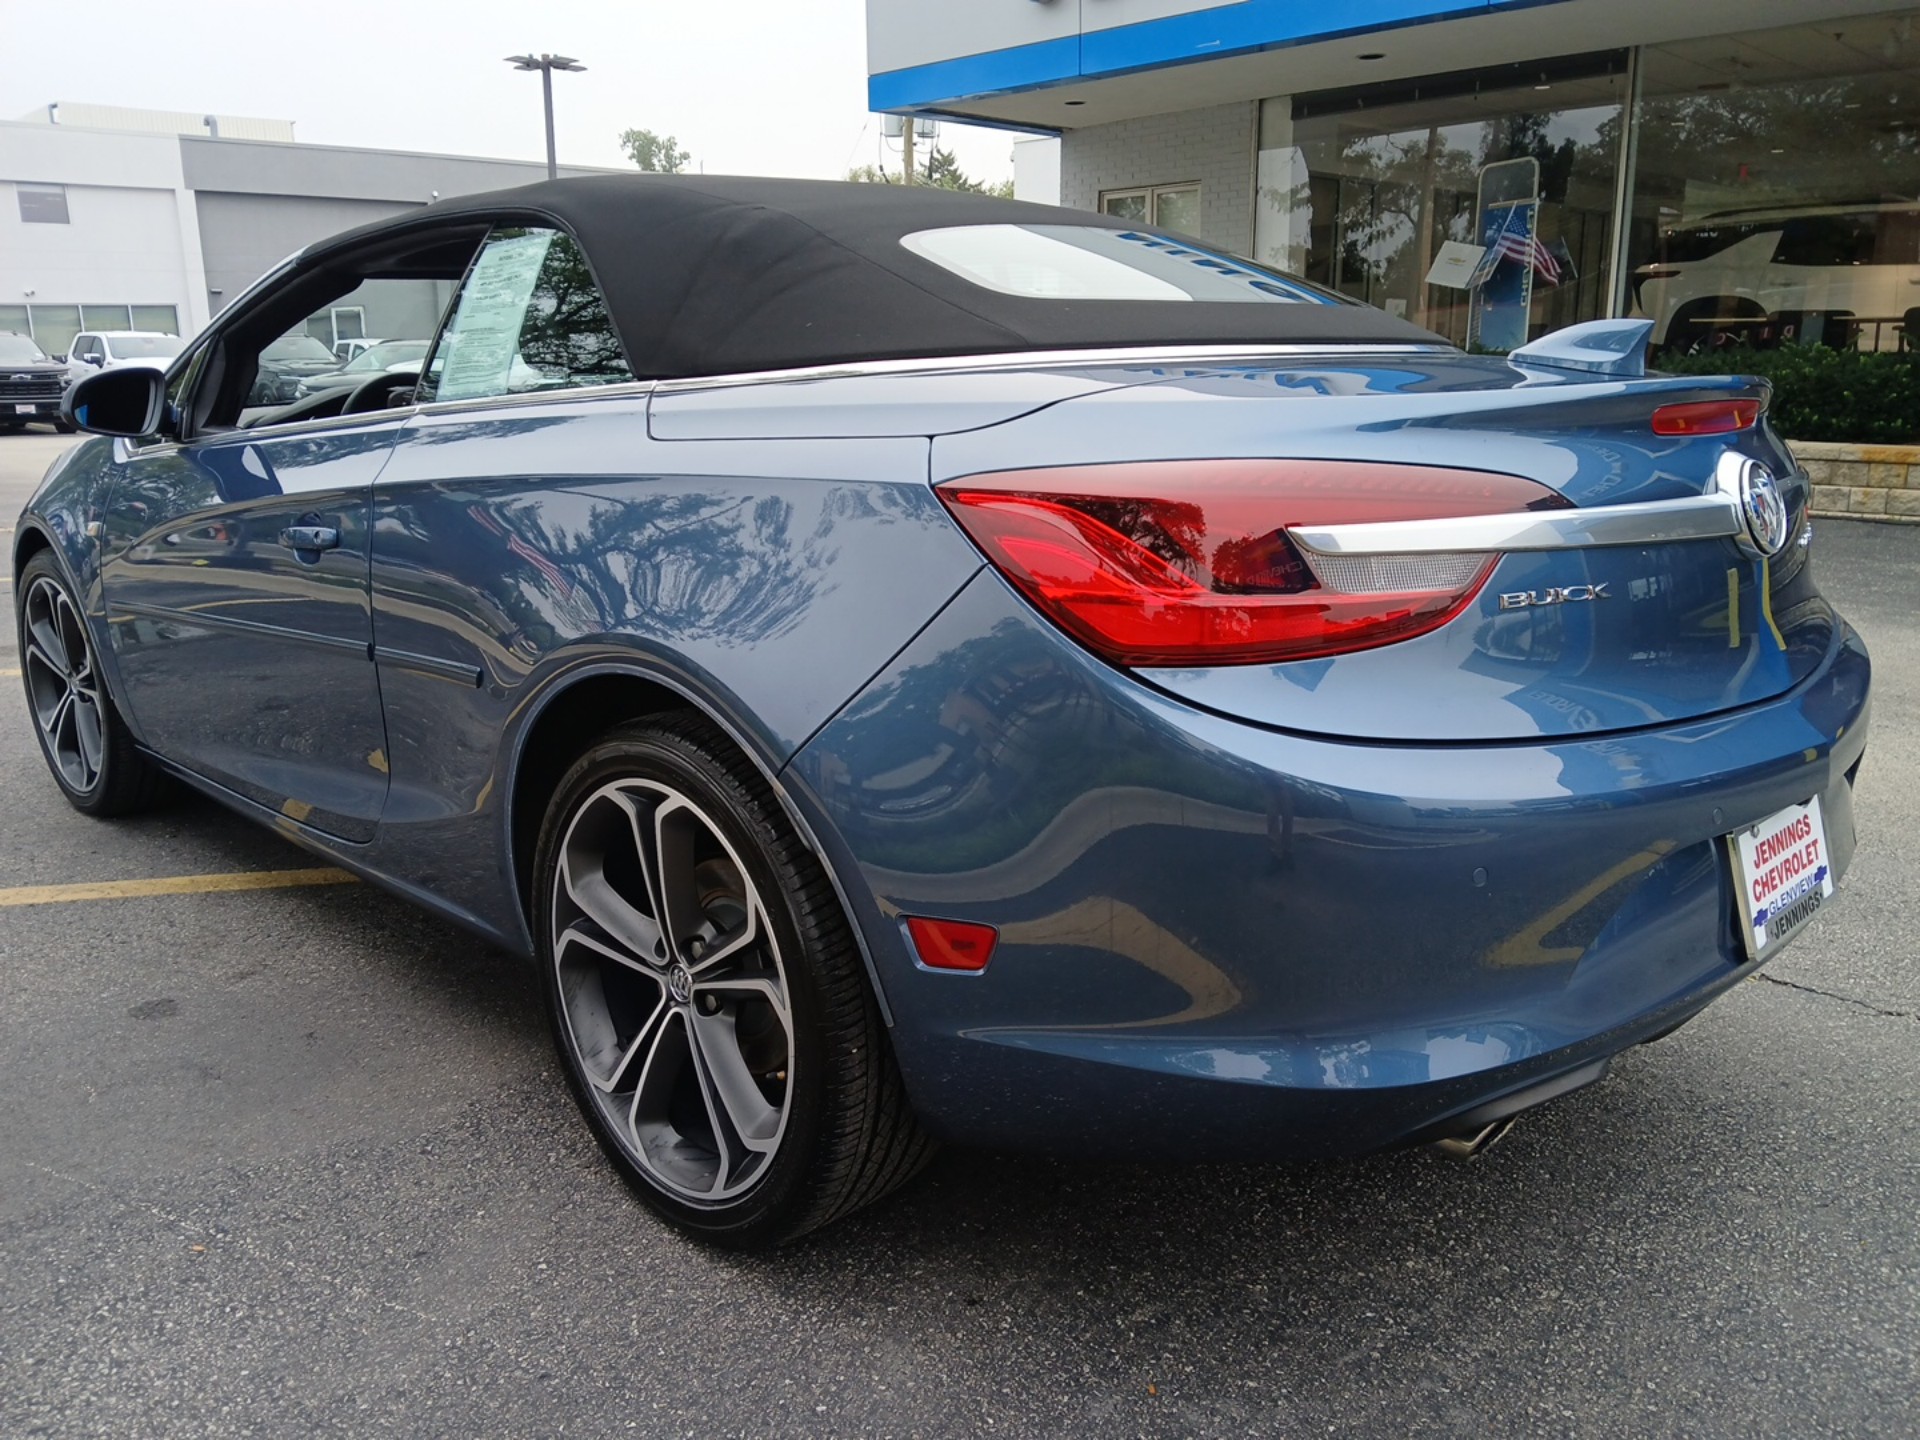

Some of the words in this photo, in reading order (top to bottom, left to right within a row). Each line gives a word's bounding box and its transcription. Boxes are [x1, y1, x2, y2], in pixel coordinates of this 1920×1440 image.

[1500, 582, 1611, 609] BUICK
[1753, 814, 1811, 869] JENNINGS
[1752, 839, 1820, 903] CHEVROLET
[1768, 873, 1815, 916] GLENVIEW
[1774, 891, 1821, 940] JENNINGS
